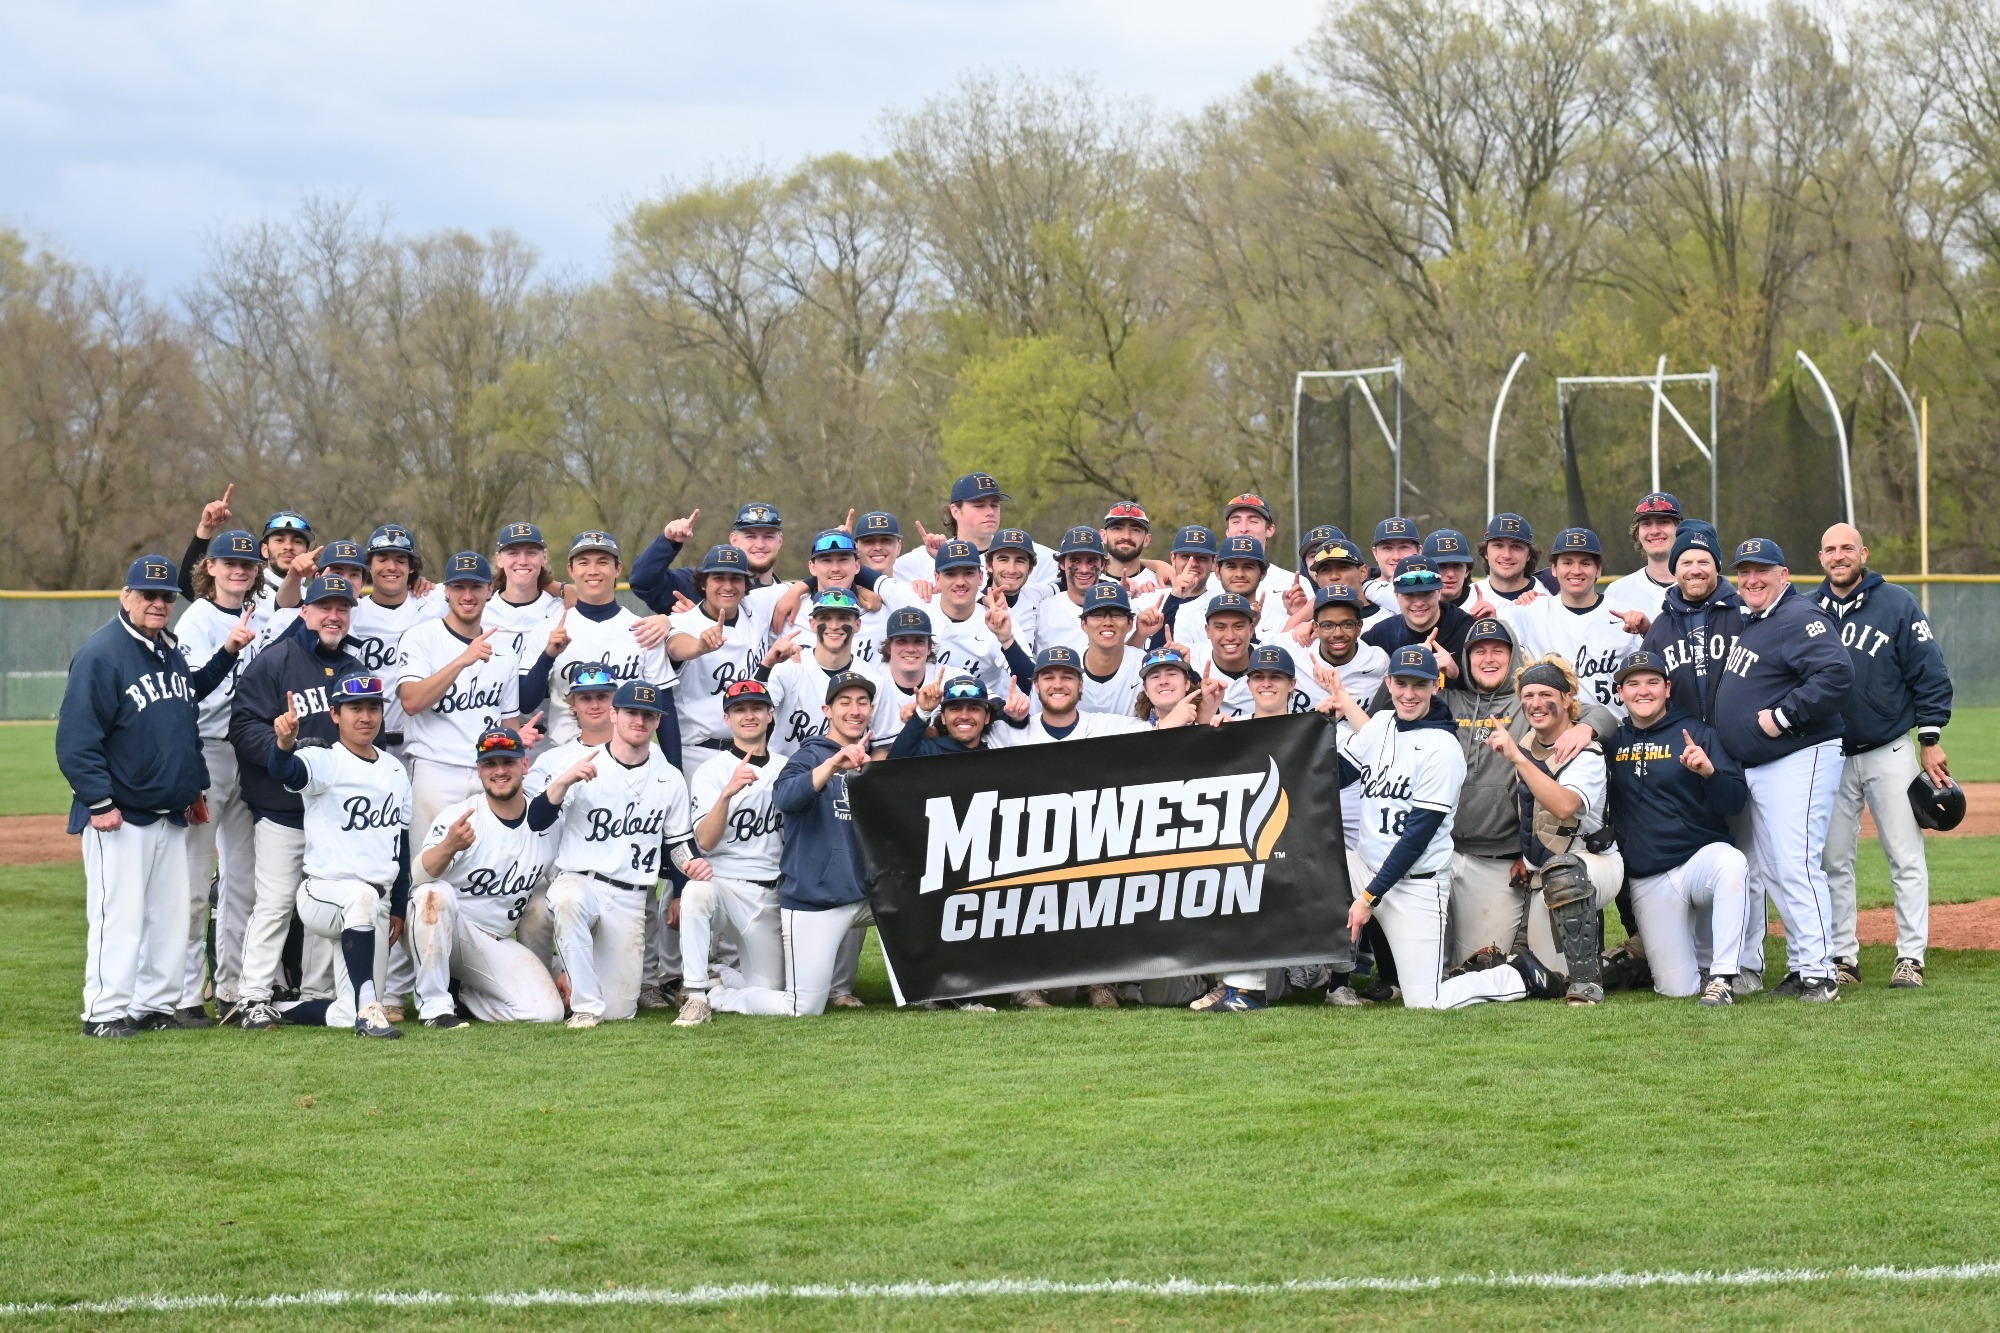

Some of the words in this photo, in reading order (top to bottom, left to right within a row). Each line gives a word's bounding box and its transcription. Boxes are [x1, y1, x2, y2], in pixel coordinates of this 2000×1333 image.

[868, 516, 889, 528] B
[1385, 521, 1405, 533] B
[1500, 519, 1520, 532] B
[510, 524, 532, 537] B
[1003, 531, 1024, 543] B
[1073, 530, 1094, 543] B
[1185, 530, 1206, 543] B
[233, 538, 254, 551] B
[1232, 538, 1253, 551] B
[1437, 538, 1458, 552] B
[1565, 533, 1587, 546] B
[948, 544, 969, 557] B
[1740, 540, 1761, 555] B
[718, 550, 739, 563] B
[456, 557, 478, 571] B
[146, 565, 168, 579] B
[325, 578, 347, 591] B
[1327, 585, 1348, 597] B
[1095, 586, 1117, 599] B
[900, 613, 922, 625] B
[1475, 622, 1497, 635] B
[1806, 620, 1826, 638] 29
[1841, 622, 1890, 658] OIT
[1049, 649, 1070, 661] B
[1258, 649, 1280, 663] B
[1401, 651, 1423, 665] B
[1575, 644, 1619, 679] loit
[1628, 653, 1649, 667] B
[1725, 645, 1760, 678] OIT
[431, 676, 503, 714] Beloit
[634, 687, 656, 702] B
[292, 686, 331, 719] BEL
[785, 709, 830, 743] Bel
[1360, 764, 1413, 801] Beloit
[341, 791, 401, 832] Belo
[584, 801, 664, 842] Beloit
[726, 801, 784, 844] Belo
[1378, 806, 1410, 837] 18
[919, 771, 1267, 895] MIDWEST
[1274, 851, 1287, 859] TM
[460, 860, 544, 896] Beloit
[940, 863, 1267, 943] CHAMPION
